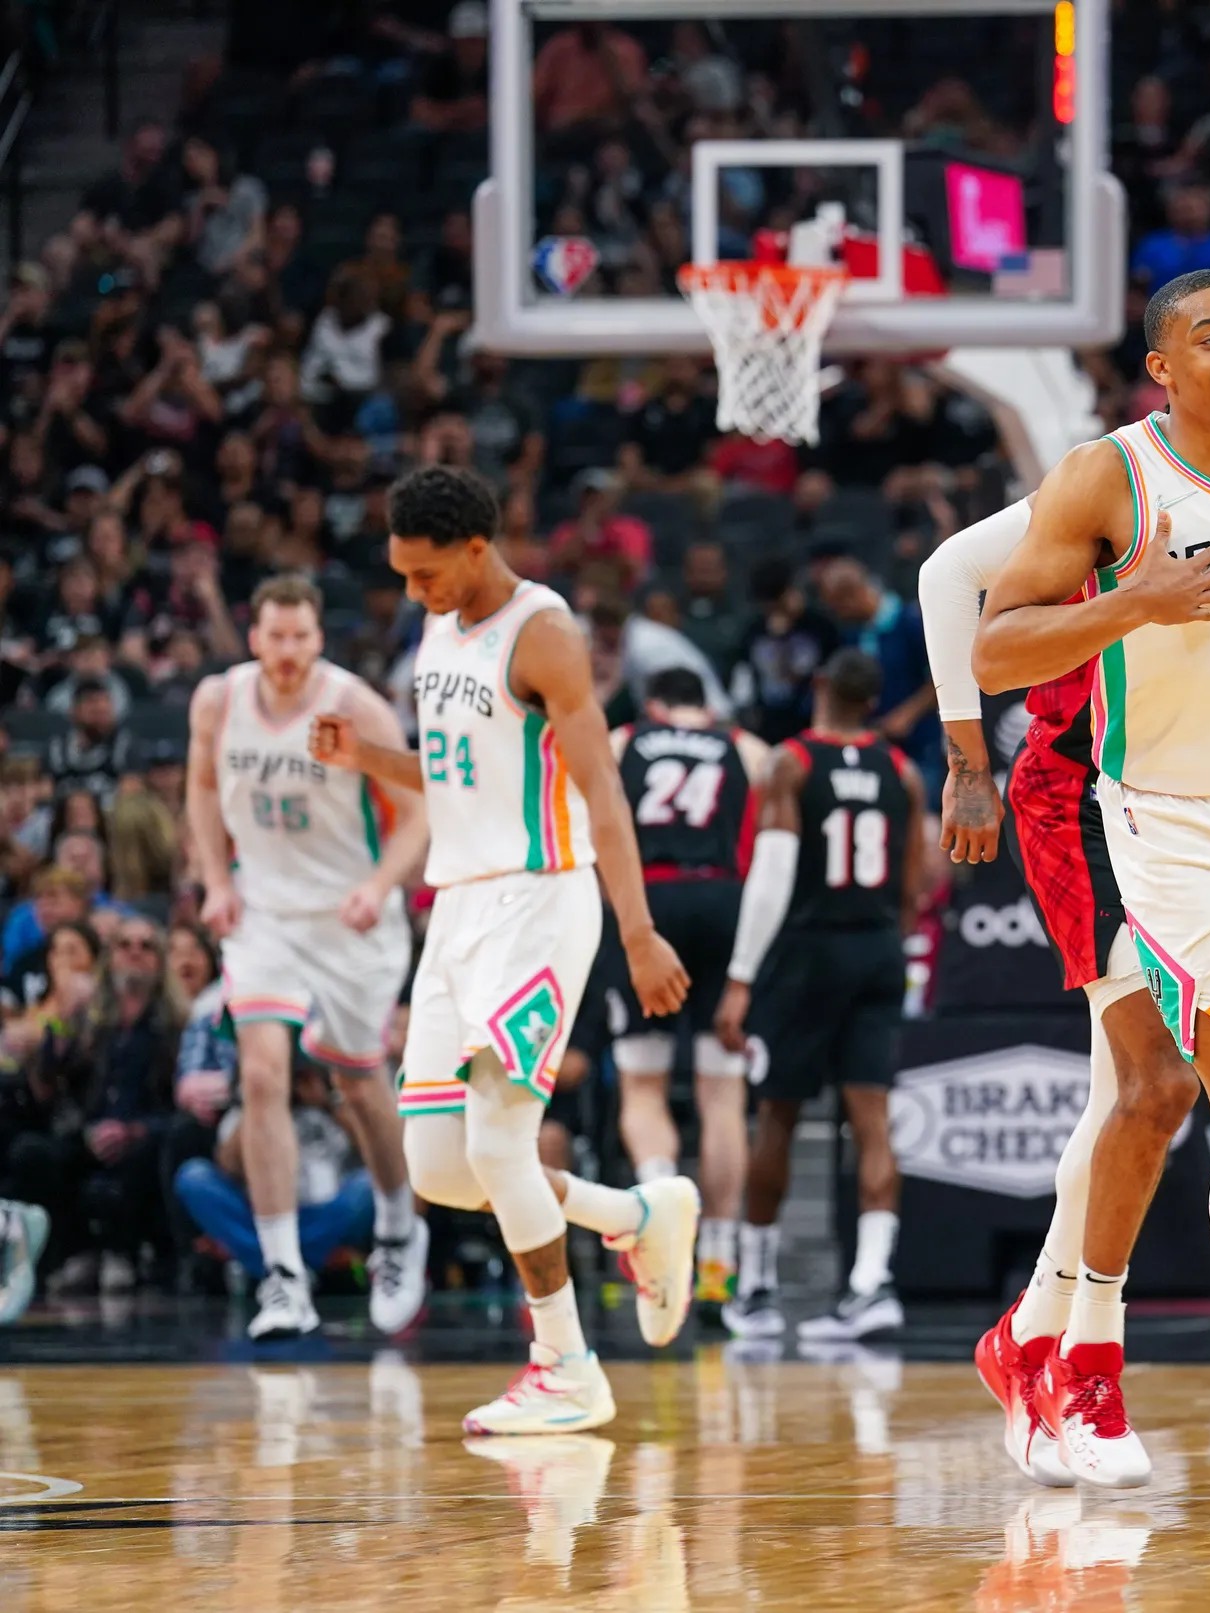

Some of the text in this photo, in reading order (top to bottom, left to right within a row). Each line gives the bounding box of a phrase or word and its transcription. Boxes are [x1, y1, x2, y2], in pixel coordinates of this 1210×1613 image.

[425, 728, 476, 788] 24
[636, 757, 725, 828] 24
[821, 806, 890, 889] 18
[944, 1082, 1090, 1117] BRAK
[940, 1126, 1076, 1164] CHEC
